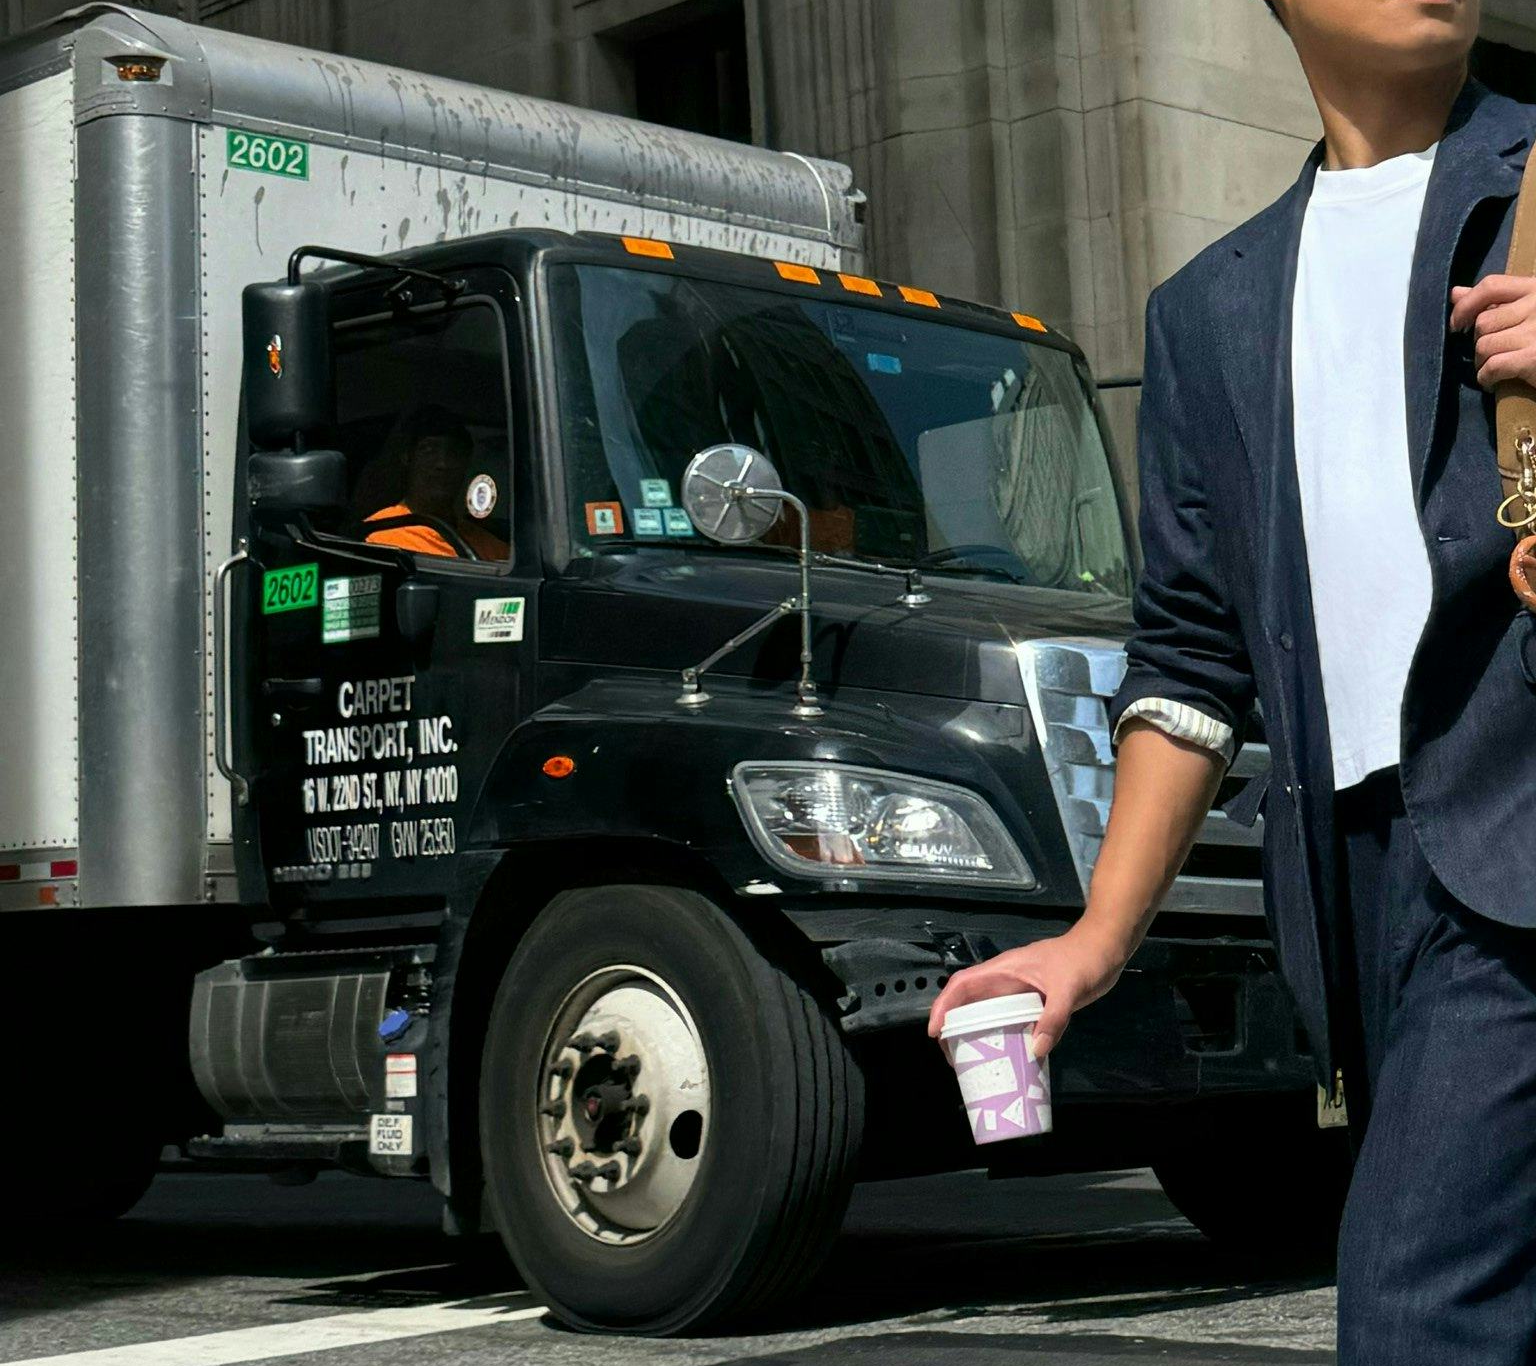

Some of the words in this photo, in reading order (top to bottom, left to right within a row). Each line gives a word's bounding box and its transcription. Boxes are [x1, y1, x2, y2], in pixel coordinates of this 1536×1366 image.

[231, 135, 304, 174] 2602
[267, 570, 314, 607] 2602
[339, 675, 415, 718] CARPET
[303, 721, 413, 765] TRANSPORT,
[419, 716, 458, 754] INC.
[303, 778, 315, 814] 16
[316, 777, 331, 812] W.
[332, 774, 360, 811] 22ND
[384, 771, 404, 813] NY,
[406, 769, 422, 805] NY
[424, 765, 458, 803] 10010
[391, 821, 418, 858] GVW
